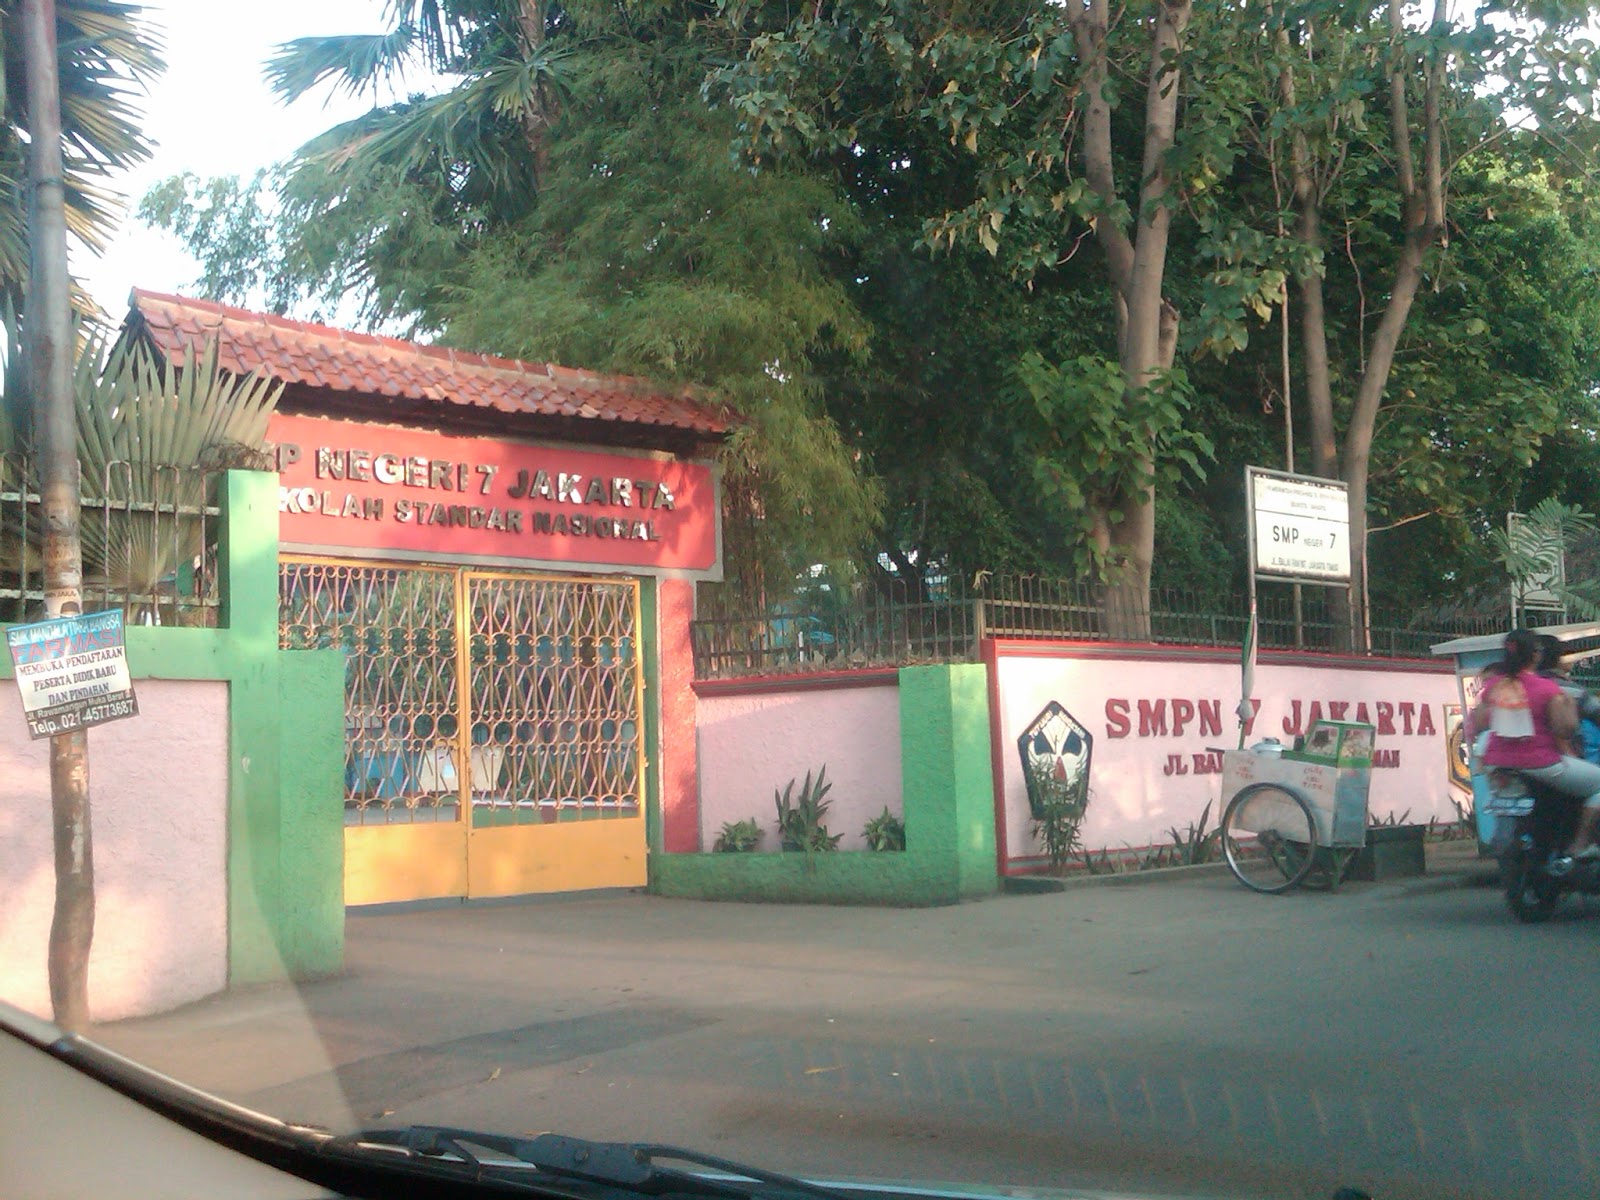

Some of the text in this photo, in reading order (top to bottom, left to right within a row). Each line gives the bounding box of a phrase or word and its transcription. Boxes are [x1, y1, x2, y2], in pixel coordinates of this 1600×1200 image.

[315, 447, 469, 493] NEGERI
[476, 464, 499, 495] 7
[507, 469, 676, 511] JAKARTA
[279, 486, 662, 541] KOLAH STANDAR NASIONAL
[1273, 525, 1299, 544] SMP
[1329, 533, 1336, 549] 7
[11, 629, 120, 664] FARMASI
[19, 648, 123, 676] MEMBUKA PENDAFTARAN
[33, 665, 117, 692] PESERTA DIDIK BARU
[48, 692, 68, 706] DAN
[69, 682, 110, 701] PINDAHAN
[1105, 698, 1223, 738] SMPN
[1282, 699, 1436, 737] JAKARTA
